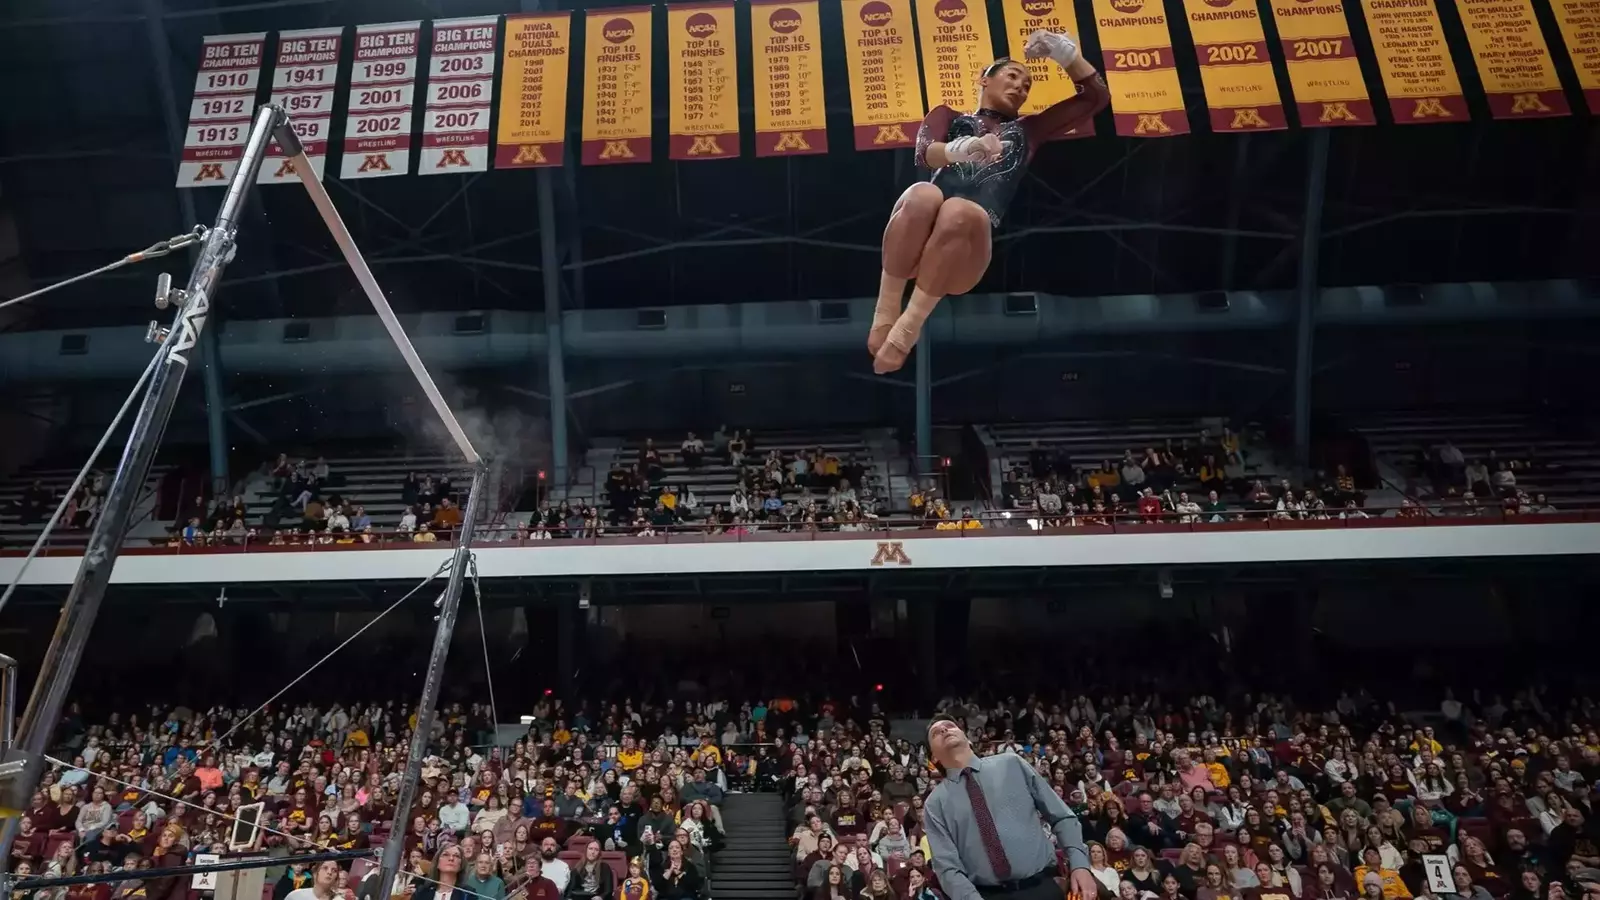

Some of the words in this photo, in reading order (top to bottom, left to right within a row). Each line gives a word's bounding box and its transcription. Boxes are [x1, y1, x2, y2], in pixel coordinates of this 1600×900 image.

[1371, 0, 1427, 9] CHAMPION
[939, 9, 967, 17] NCAA
[1191, 10, 1256, 22] CHAMPIONS
[1277, 5, 1342, 16] CHAMPIONS
[864, 13, 892, 21] NCAA
[1100, 16, 1164, 27] CHAMPIONS
[524, 23, 552, 31] NWCA
[689, 24, 716, 32] NCAA
[773, 20, 800, 28] NCAA
[1024, 19, 1042, 27] TOP
[436, 30, 461, 42] BIG
[465, 28, 492, 39] TEN
[515, 32, 560, 40] NATIONAL
[606, 29, 634, 37] NCAA
[933, 33, 979, 43] FINISHES
[360, 35, 384, 47] BIG
[388, 33, 415, 45] TEN
[522, 40, 552, 48] DUALS
[858, 37, 902, 46] FINISHES
[205, 46, 229, 58] BIG
[233, 44, 260, 56] TEN
[282, 41, 306, 53] BIG
[310, 39, 336, 51] TEN
[435, 41, 492, 52] CHAMPIONS
[765, 44, 810, 53] FINISHES
[1294, 41, 1342, 57] 2007
[280, 52, 336, 63] CHAMPIONS
[358, 46, 414, 58] CHAMPIONS
[508, 48, 564, 57] CHAMPIONS
[597, 53, 640, 62] FINISHES
[682, 48, 724, 57] FINISHES
[1208, 45, 1258, 62] 2002
[203, 56, 258, 67] CHAMPIONS
[440, 57, 483, 72] 2003
[1115, 51, 1161, 67] 2001
[364, 62, 406, 78] 1999
[938, 63, 960, 71] 2008
[208, 74, 248, 87] 1910
[286, 69, 324, 82] 1941
[1307, 80, 1350, 88] WRESTLING
[360, 90, 401, 104] 2001
[438, 84, 481, 100] 2006
[203, 101, 243, 114] 1912
[281, 96, 322, 110] 1957
[357, 117, 400, 133] 2002
[435, 112, 479, 127] 2007
[197, 128, 239, 142] 1913
[1435, 866, 1442, 878] 4
